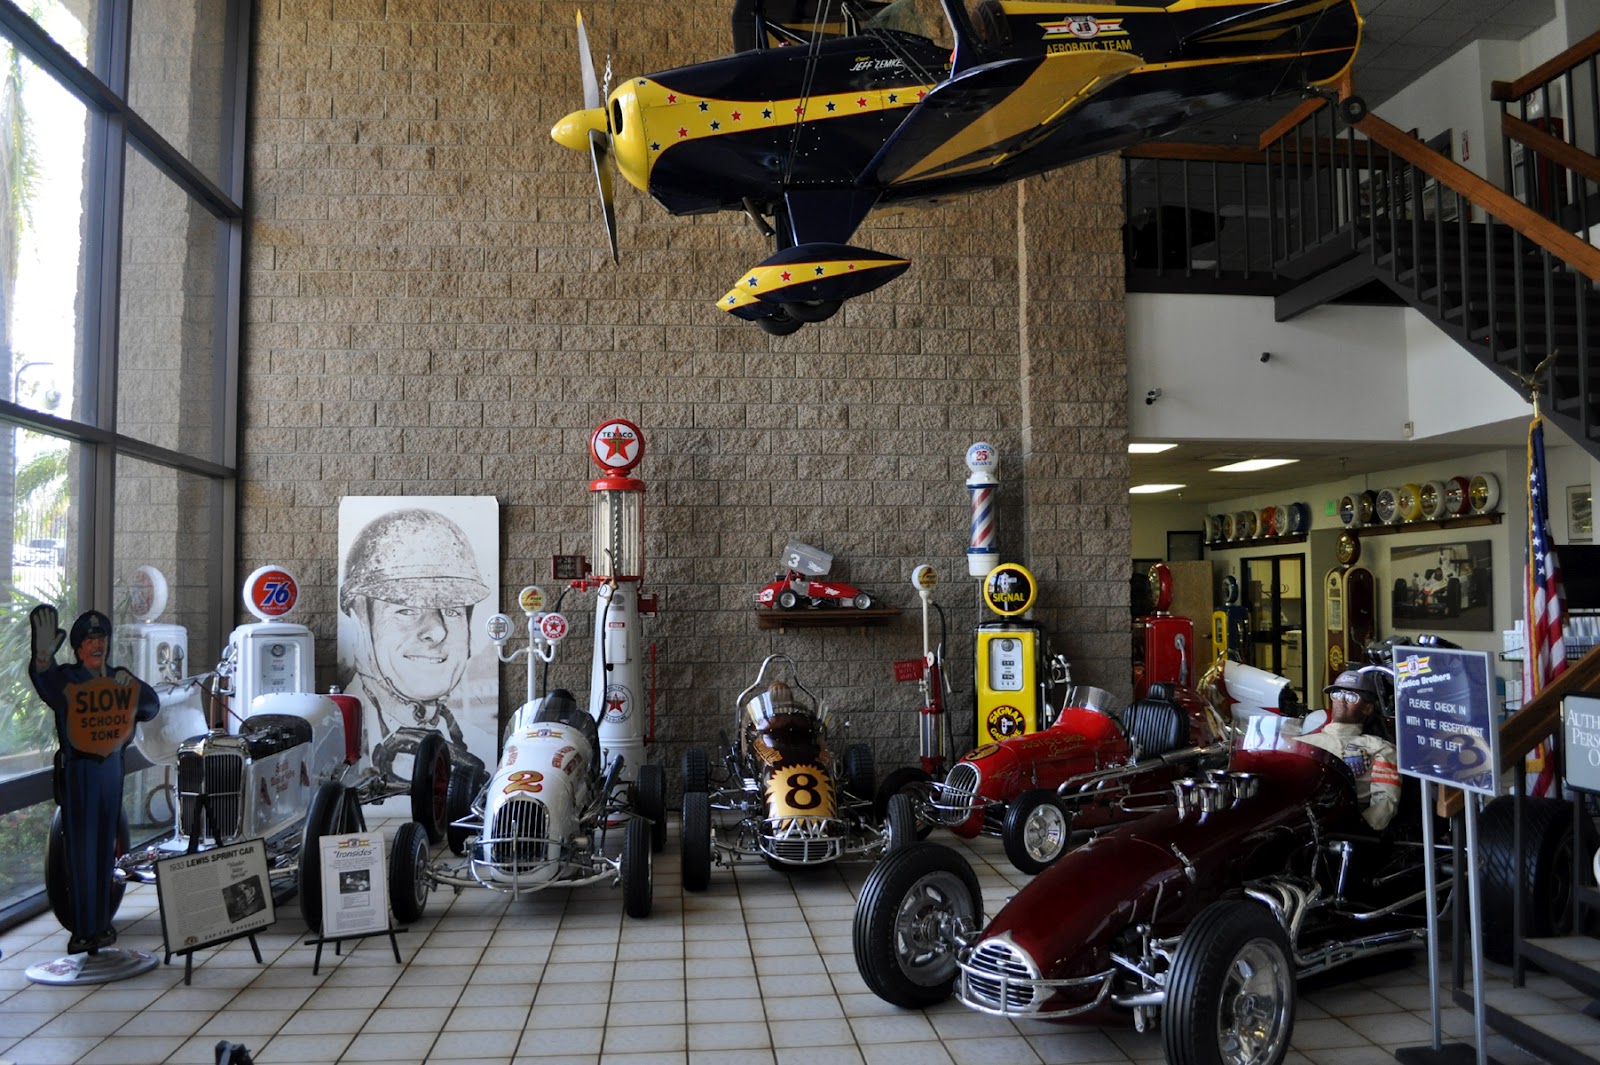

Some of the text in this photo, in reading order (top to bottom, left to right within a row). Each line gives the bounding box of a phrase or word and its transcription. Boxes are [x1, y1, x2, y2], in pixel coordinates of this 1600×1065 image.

[1046, 39, 1132, 54] AEROBATIC TEAM
[849, 60, 873, 71] JEFF
[610, 439, 625, 454] T
[787, 553, 801, 568] 3
[260, 581, 292, 606] 76
[763, 588, 775, 602] 3
[992, 592, 1025, 602] SIGNAL
[1397, 672, 1451, 689] Justice Brothers
[75, 688, 132, 714] SLOW
[1408, 697, 1466, 715] PLEASE CHECK IN
[81, 715, 129, 728] SCHOOL
[989, 706, 1023, 725] SIGNAL
[91, 729, 120, 741] ZONE
[1406, 715, 1484, 738] WITH THE RECEPTIONIST
[1019, 737, 1061, 750] JUSTICE
[1416, 735, 1463, 753] TO THE LEFT
[1572, 727, 1600, 748] PERS
[503, 770, 545, 795] 2
[785, 773, 822, 810] 8
[169, 846, 255, 872] 1933 LEWIS SPRINT CAR
